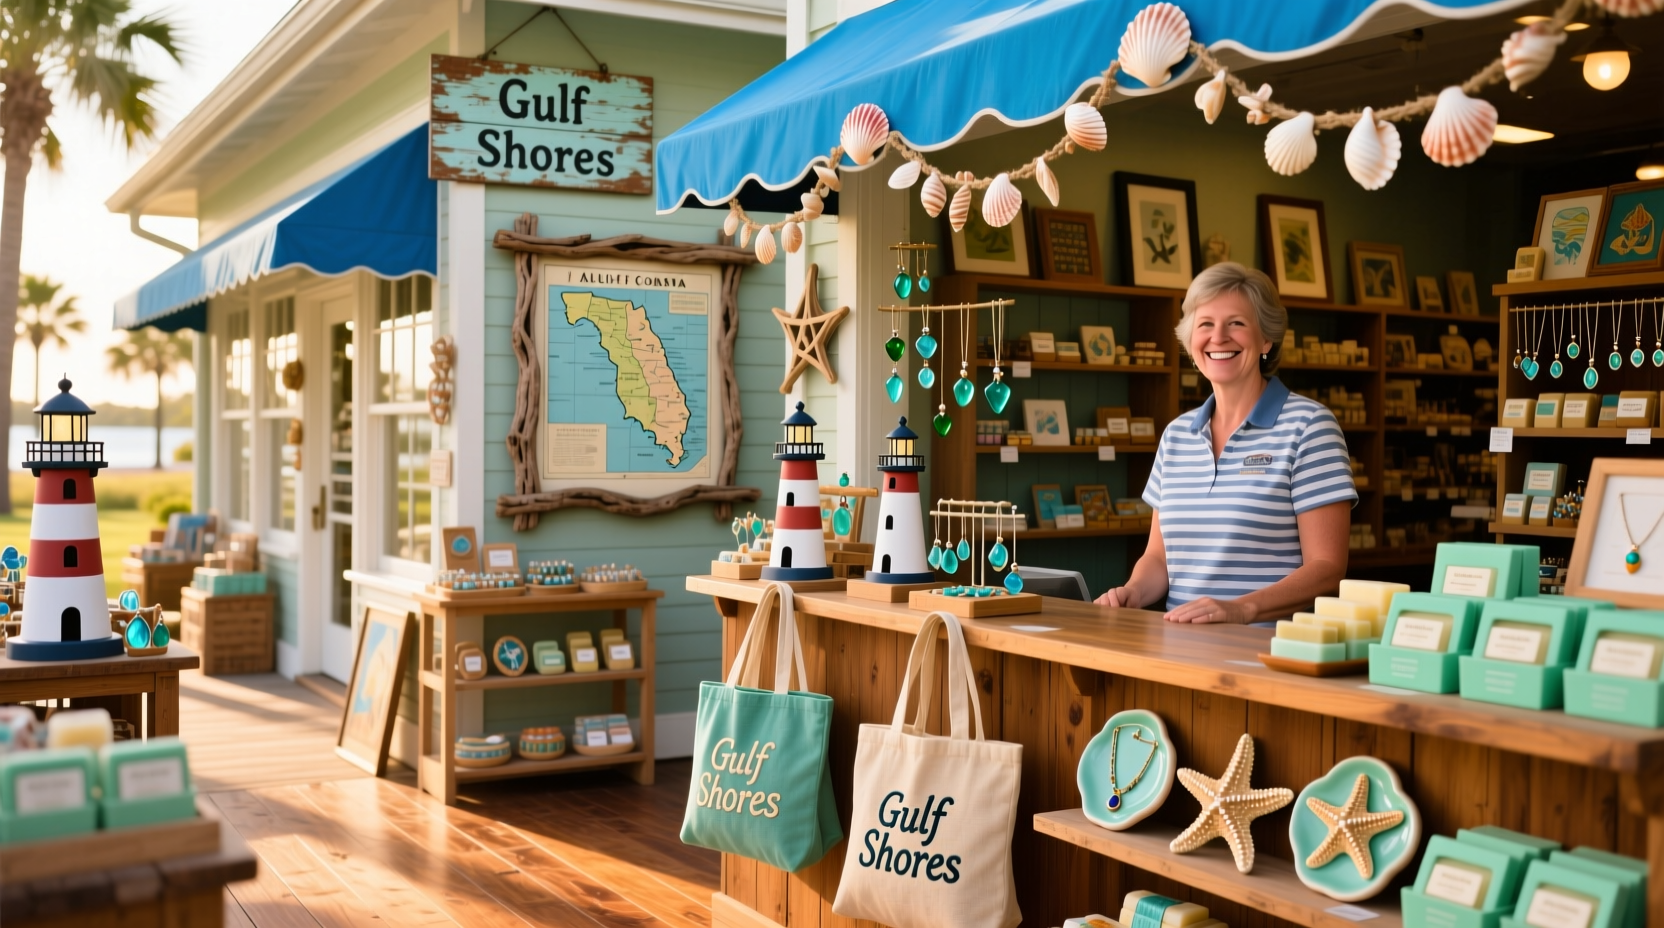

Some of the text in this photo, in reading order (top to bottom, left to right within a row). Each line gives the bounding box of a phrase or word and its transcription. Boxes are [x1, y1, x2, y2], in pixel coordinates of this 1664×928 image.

[499, 78, 591, 125] Gulf
[477, 128, 615, 177] Shores
[711, 737, 776, 785] Gulf
[696, 771, 781, 819] Shores
[878, 790, 954, 846] Gulf
[858, 828, 962, 884] Shores
